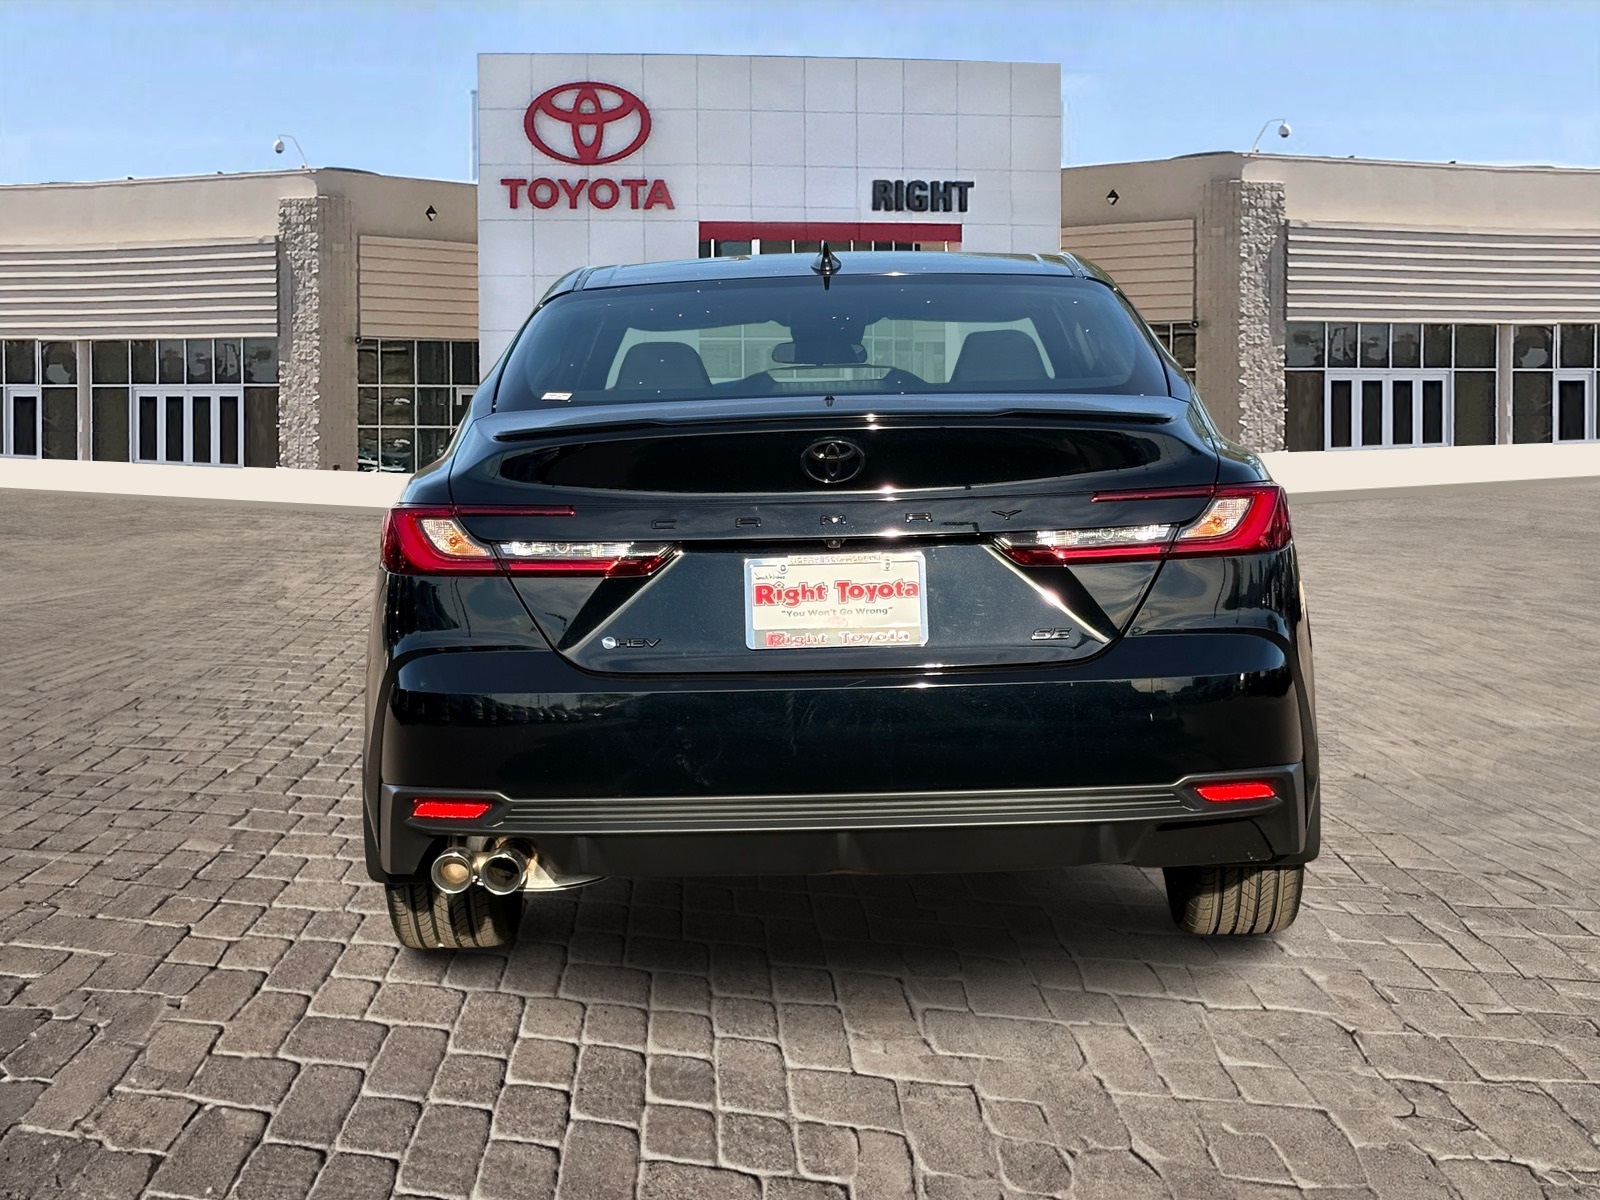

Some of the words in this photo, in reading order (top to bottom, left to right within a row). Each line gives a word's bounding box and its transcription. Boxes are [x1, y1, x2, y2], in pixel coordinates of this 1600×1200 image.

[500, 178, 676, 210] TOYOTA
[871, 180, 975, 212] RIGHT
[651, 509, 1022, 529] CAMRY
[753, 581, 827, 607] Right
[835, 579, 919, 604] Toyota
[808, 608, 837, 617] Won't
[839, 608, 853, 616] Go
[765, 632, 828, 646] Right
[839, 630, 910, 645] Toyota
[1031, 627, 1072, 640] SE
[616, 638, 661, 648] HEV
